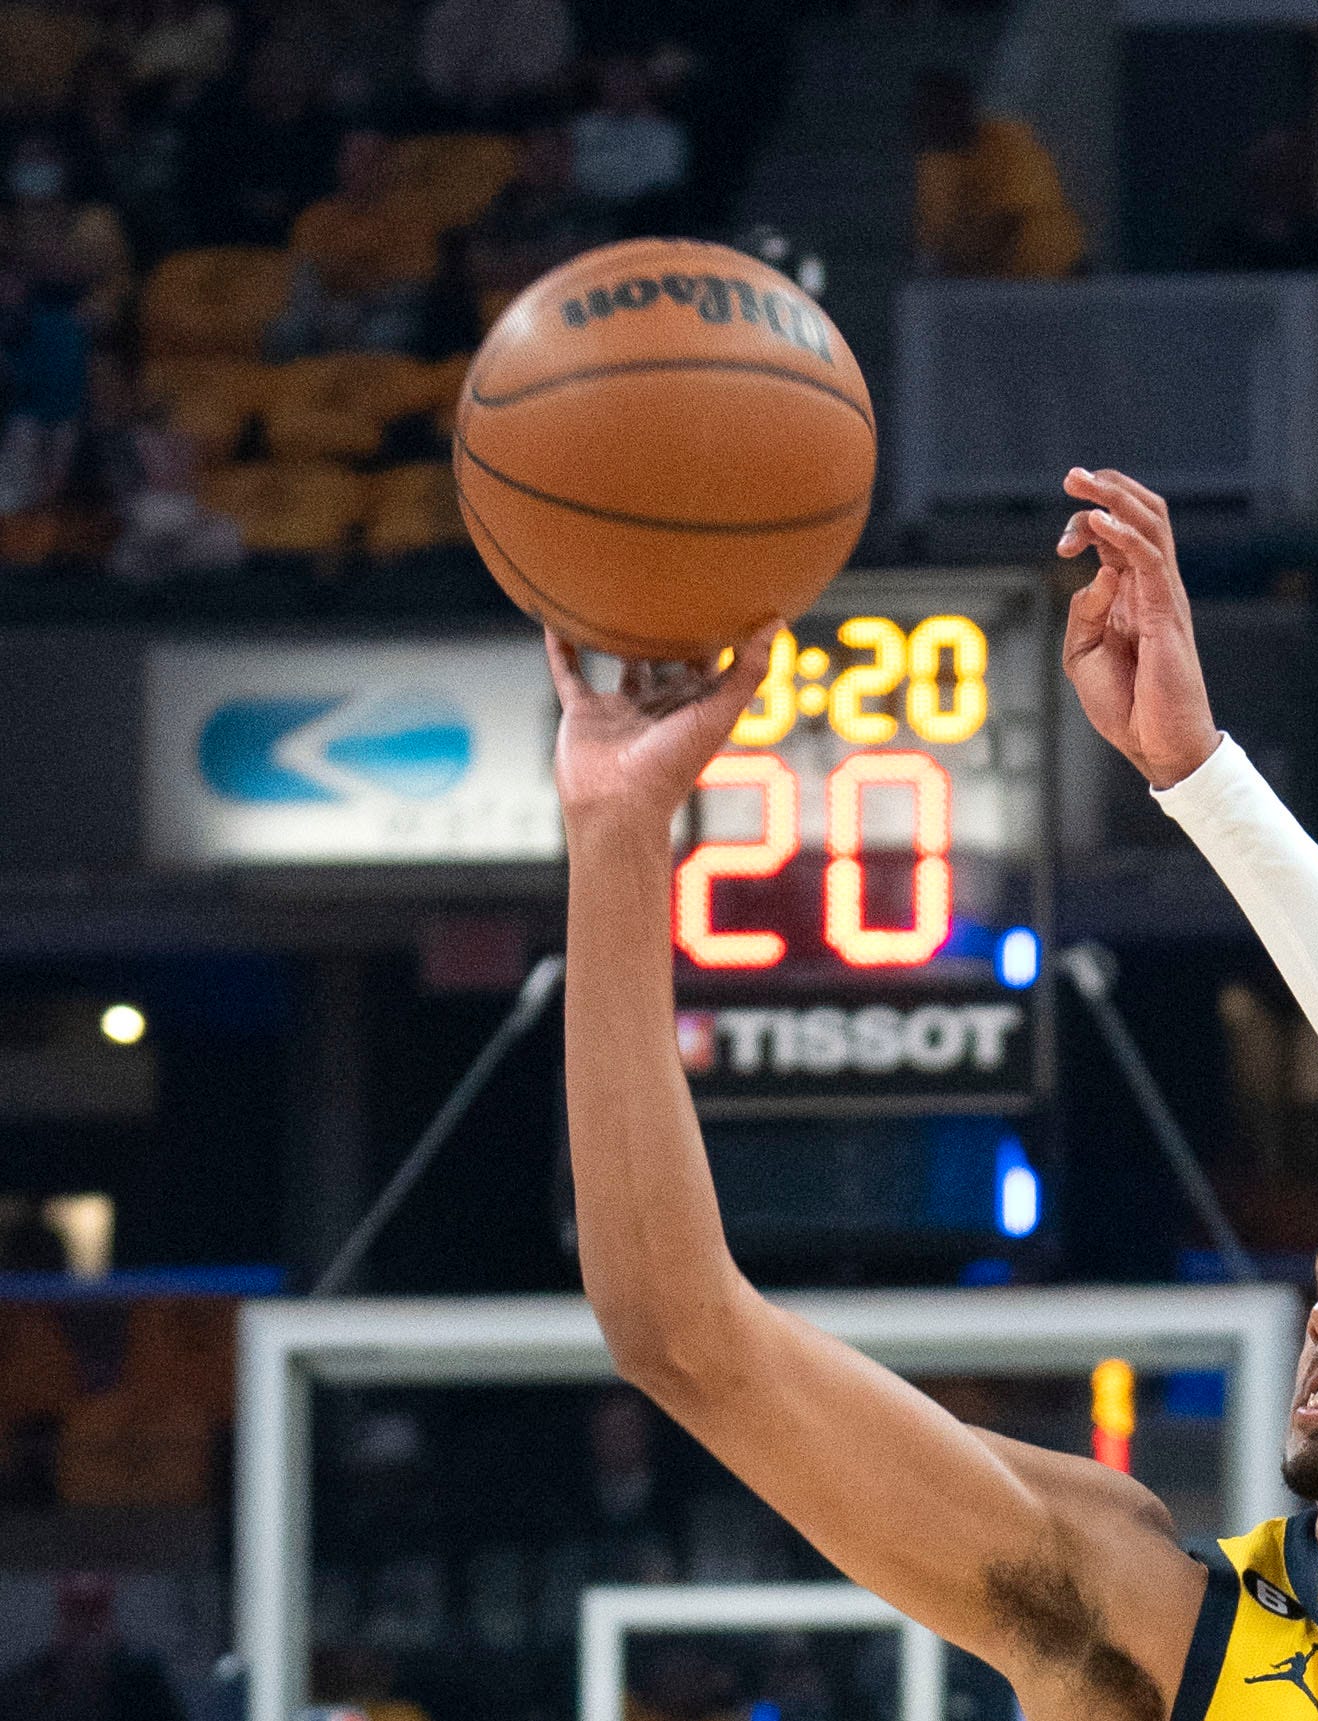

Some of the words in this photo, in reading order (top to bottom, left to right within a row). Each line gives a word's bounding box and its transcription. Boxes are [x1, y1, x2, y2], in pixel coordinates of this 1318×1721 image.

[560, 272, 835, 366] Wilson
[672, 750, 952, 968] 20
[719, 1002, 1023, 1075] TISSOT
[1256, 1579, 1288, 1615] 6
